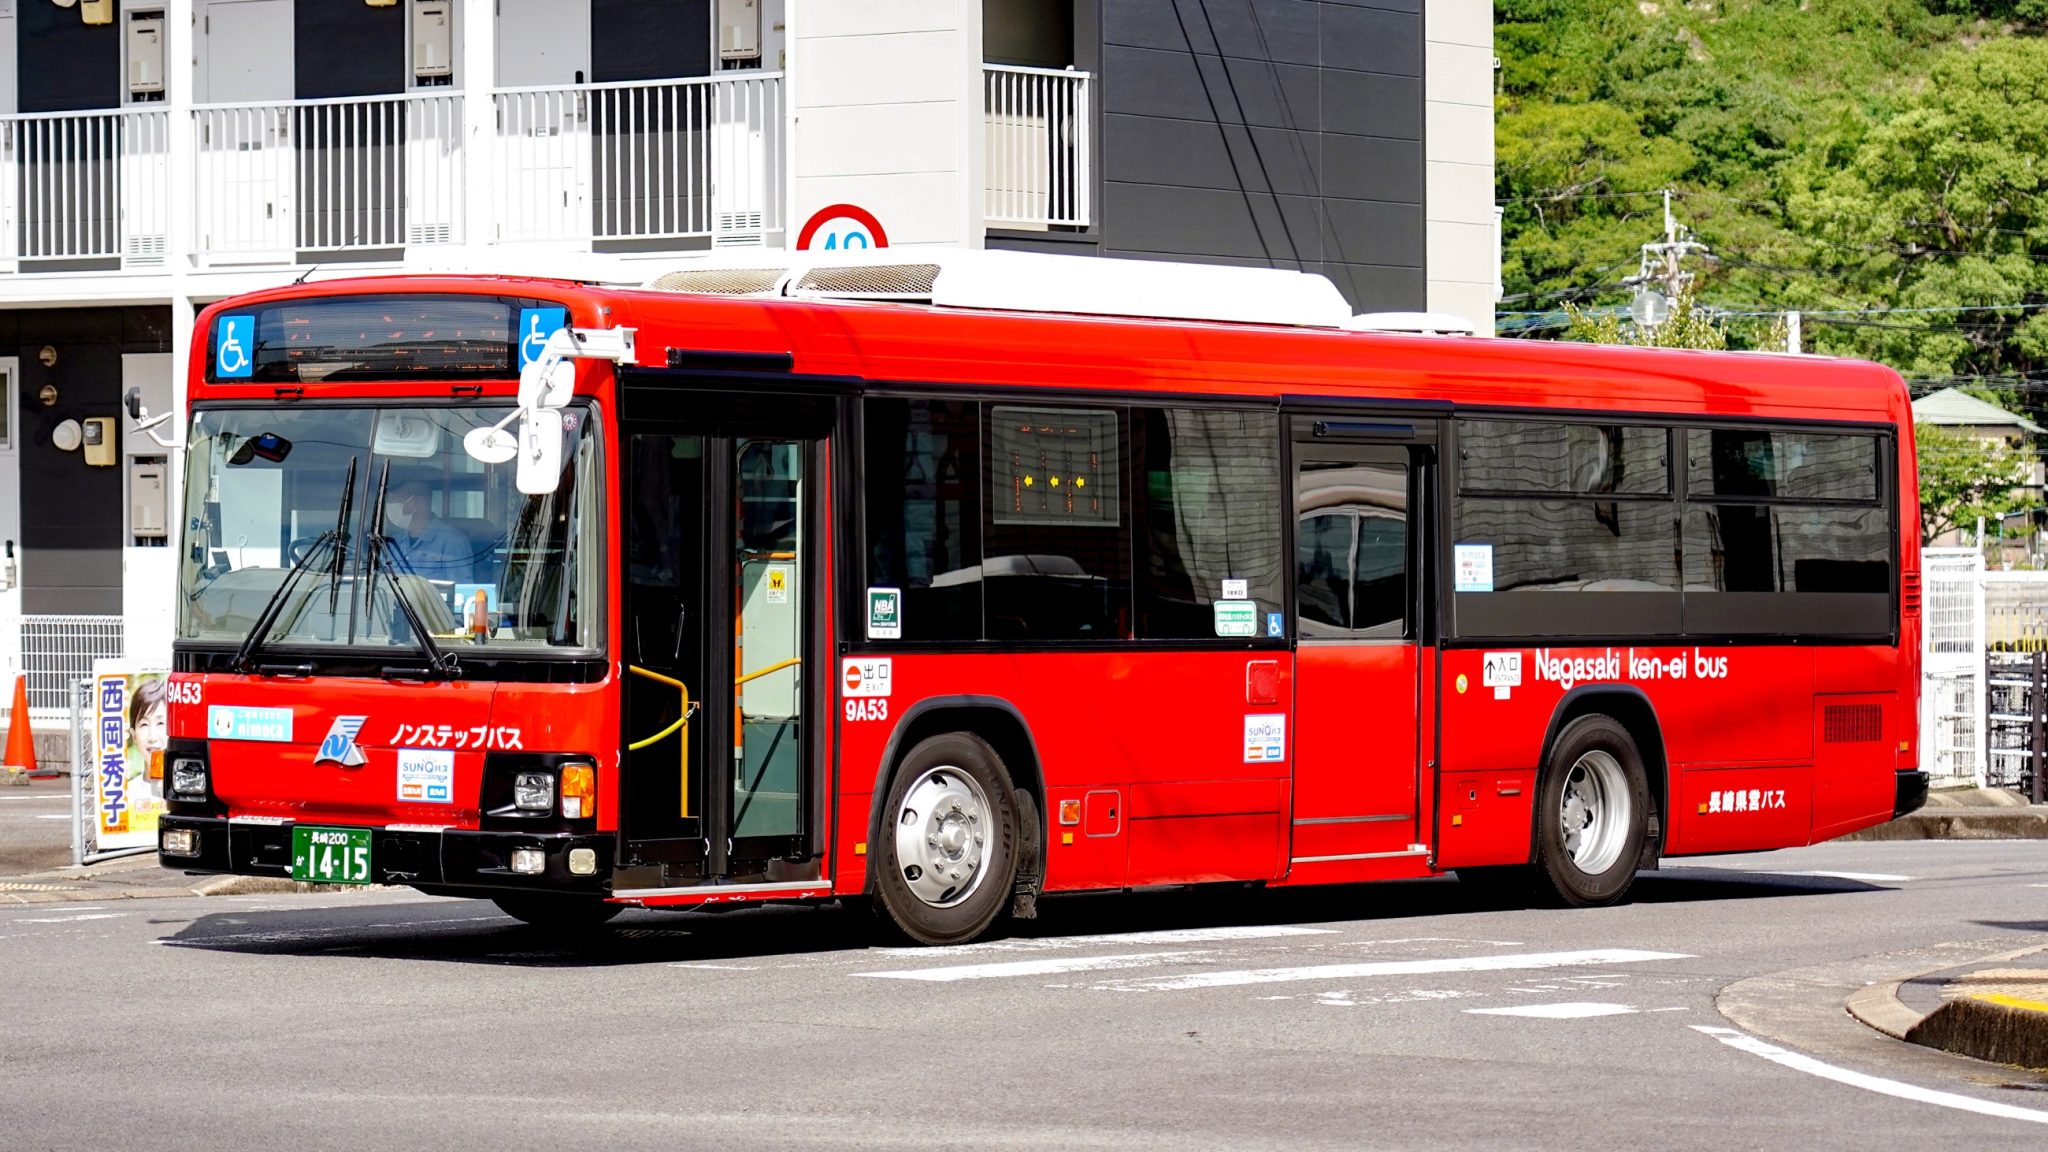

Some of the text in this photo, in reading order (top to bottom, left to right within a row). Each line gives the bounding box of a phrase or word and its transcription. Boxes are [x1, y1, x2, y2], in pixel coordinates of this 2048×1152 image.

[874, 600, 894, 613] NBA
[864, 664, 888, 679] 出口
[1498, 657, 1517, 671] 入口
[1535, 646, 1728, 690] Nagasaki ken-ei bus
[167, 682, 202, 704] 9A53
[866, 683, 885, 692] EXIT
[845, 699, 888, 721] 9A53
[389, 723, 523, 750] ノンステップバス
[101, 680, 126, 824] 西岡秀子
[1708, 789, 1785, 813] 長崎県営バス
[309, 845, 368, 880] 14-15
